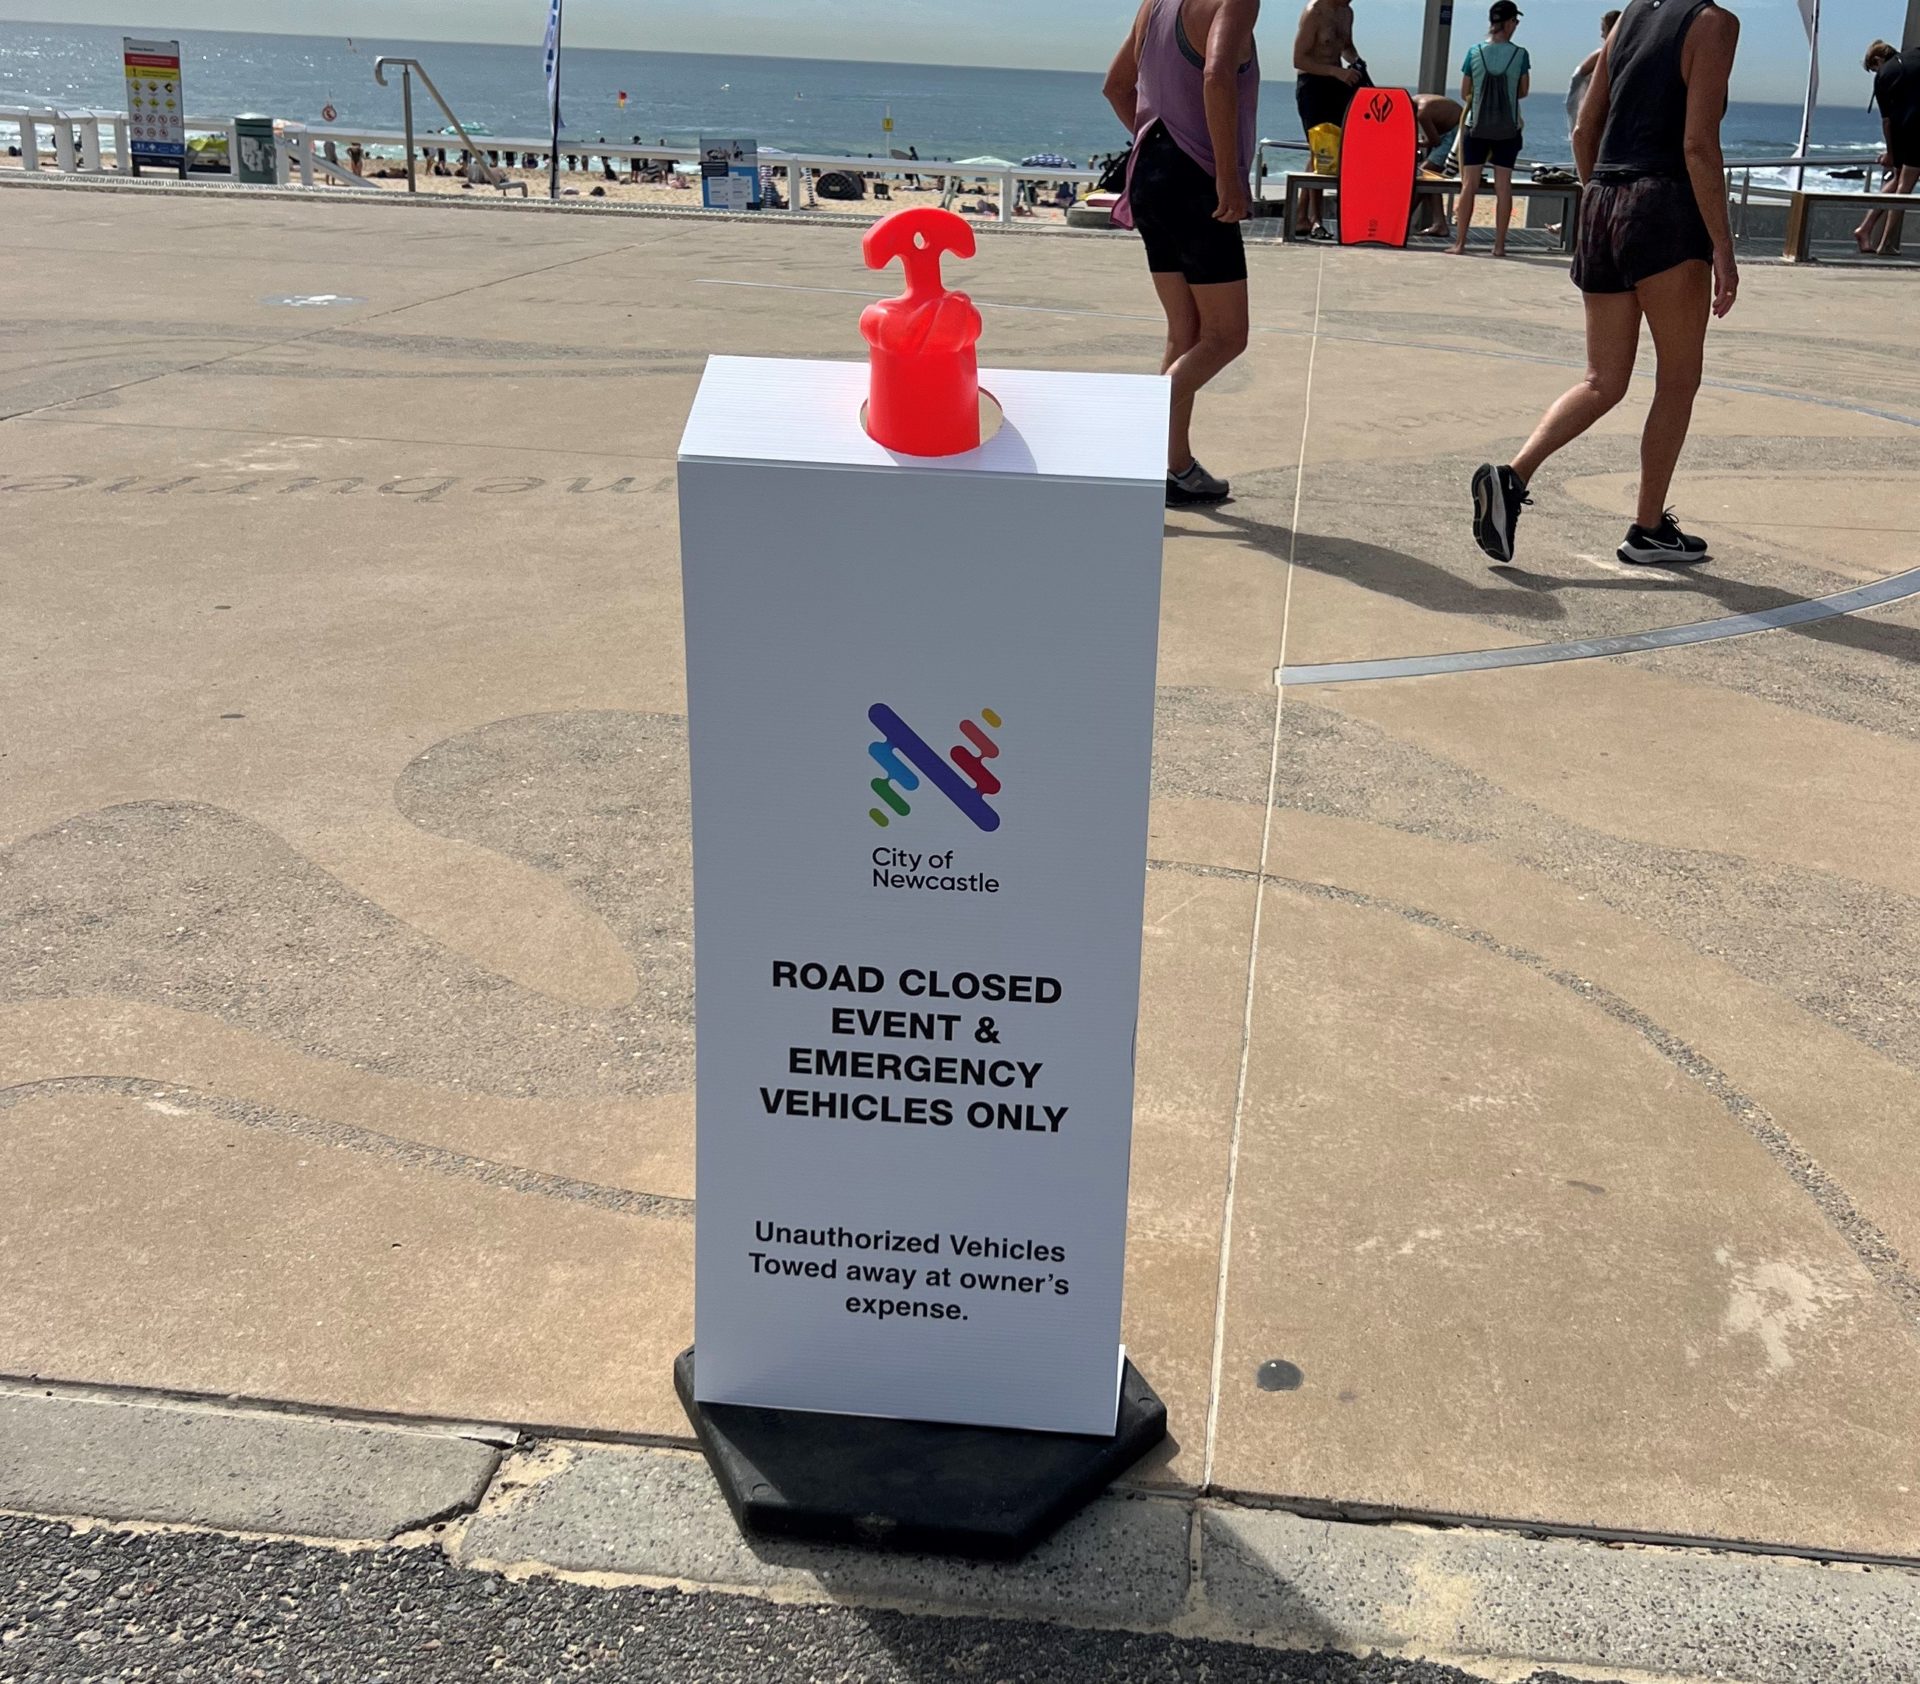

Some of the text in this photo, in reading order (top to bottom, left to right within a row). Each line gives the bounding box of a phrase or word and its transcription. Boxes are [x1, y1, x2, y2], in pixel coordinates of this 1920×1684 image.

[0, 474, 677, 503] meburne
[872, 846, 954, 873] City of
[873, 868, 1000, 893] Newcastle
[772, 960, 1062, 1004] ROAD CLOSED
[831, 1007, 1001, 1044] EVENT &
[789, 1047, 1043, 1089] EMERGENCY
[759, 1087, 1069, 1133] VEHICLES ONLY
[755, 1220, 1066, 1263] Unauthorized Vehicles
[748, 1252, 1069, 1296] Towed away at owner’s
[845, 1296, 968, 1321] expense.
